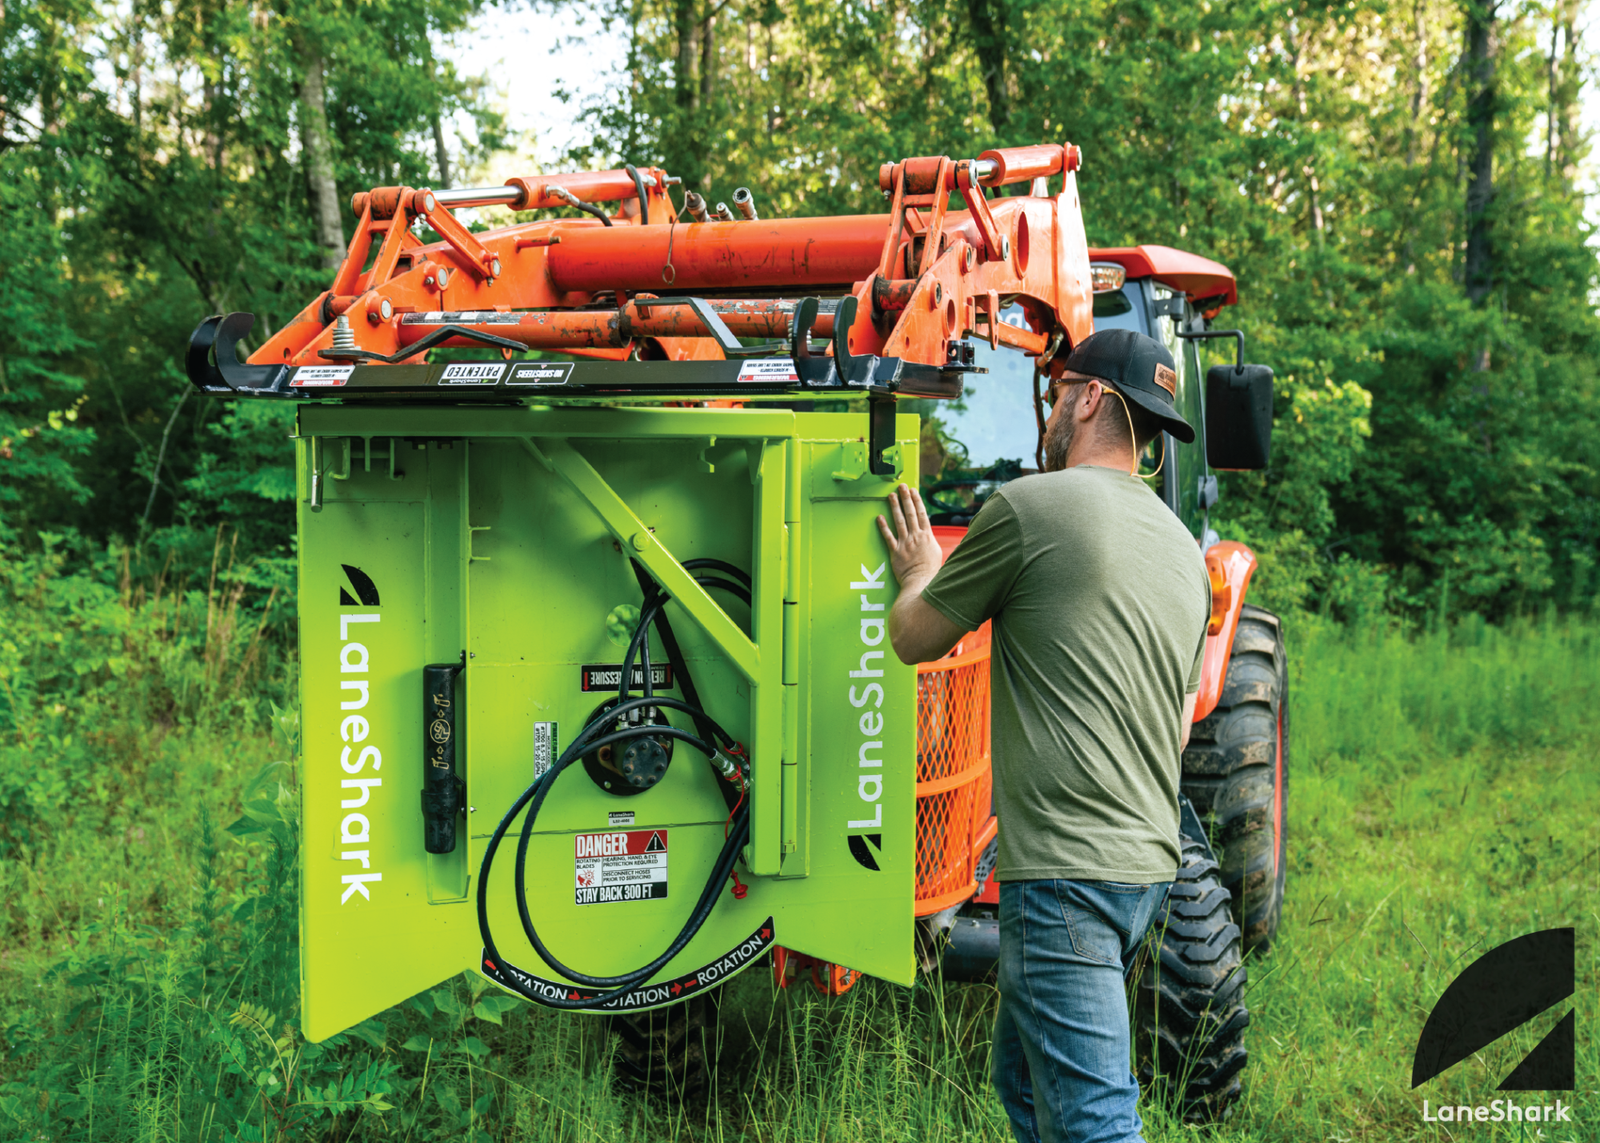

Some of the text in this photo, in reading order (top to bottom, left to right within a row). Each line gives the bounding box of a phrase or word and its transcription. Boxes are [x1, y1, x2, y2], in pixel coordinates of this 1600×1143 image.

[446, 366, 501, 378] PATENTED
[554, 369, 565, 378] NO
[590, 671, 623, 686] RESSURE
[635, 670, 665, 685] RETRN
[846, 561, 886, 829] LaneShark
[340, 613, 382, 906] LaneShark
[576, 833, 628, 857] DANGER
[576, 883, 653, 903] STAY BACK 300 FT
[696, 935, 763, 985] ROTATION
[495, 969, 568, 1000] TATION
[598, 985, 670, 1007] TATION
